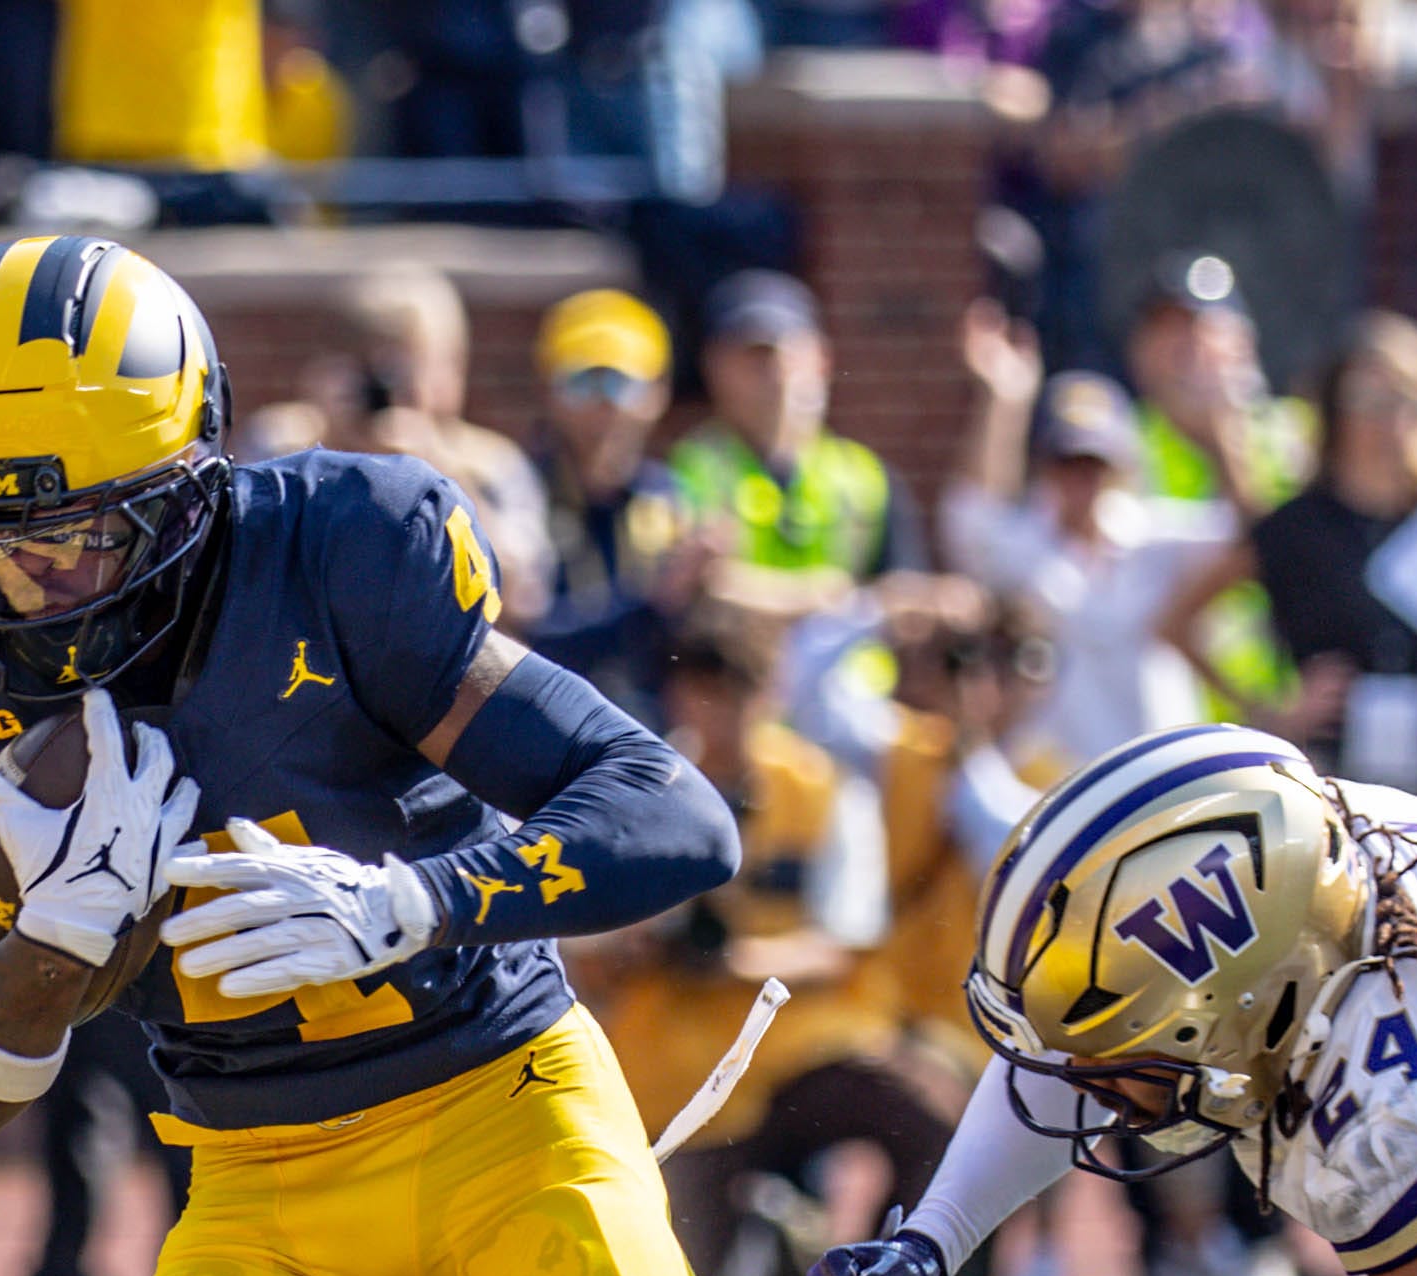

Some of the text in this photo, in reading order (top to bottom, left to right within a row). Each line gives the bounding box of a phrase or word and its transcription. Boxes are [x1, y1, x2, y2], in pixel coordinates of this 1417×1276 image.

[445, 504, 502, 624] 4
[515, 833, 588, 906] M
[1110, 838, 1260, 990] W
